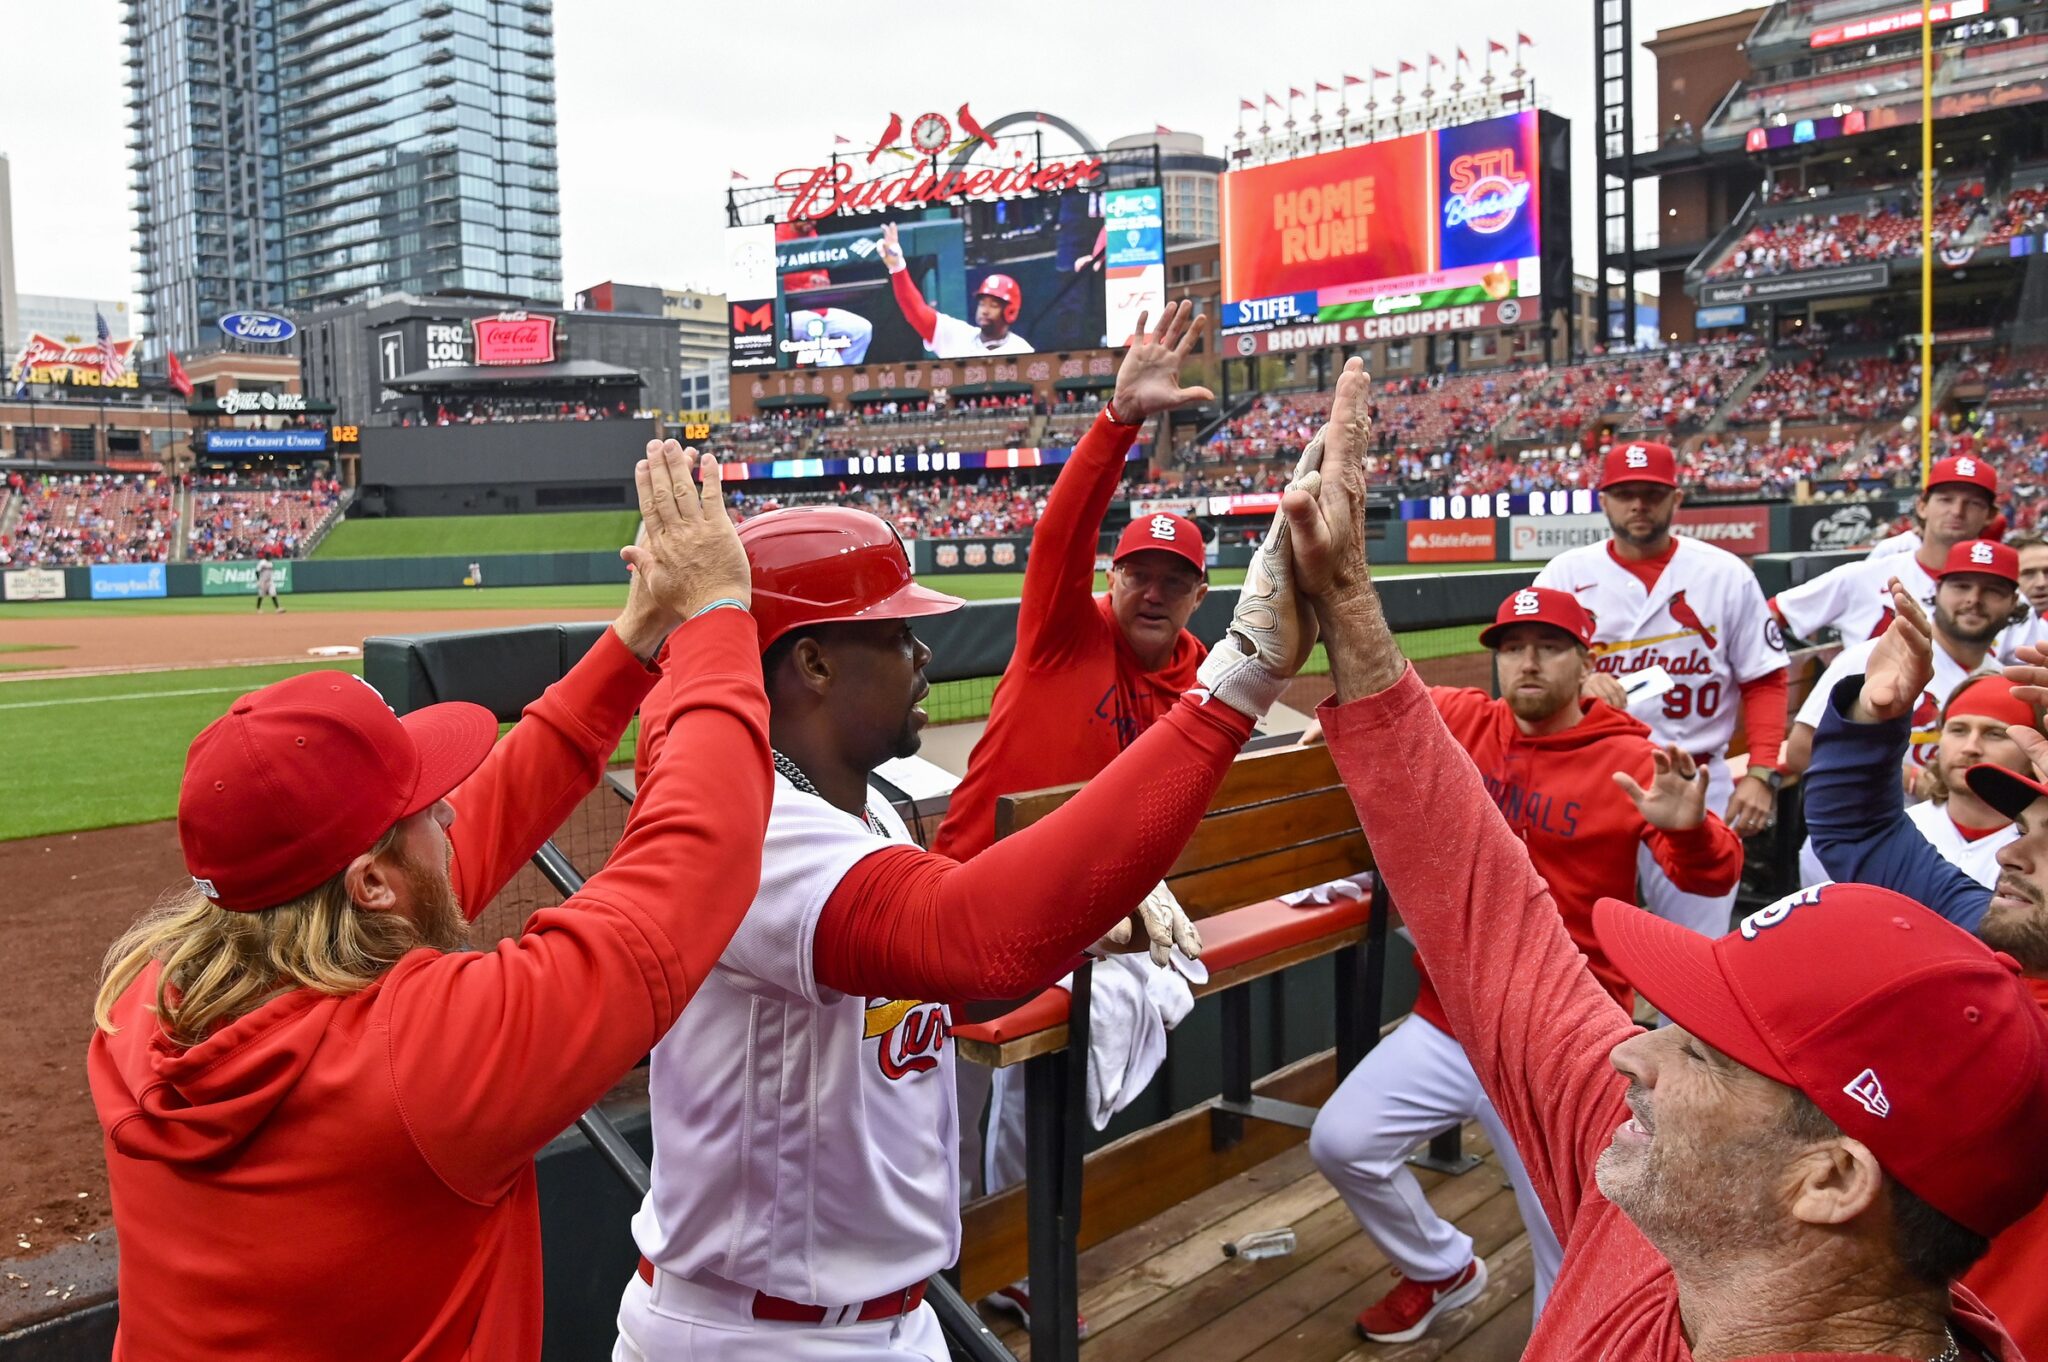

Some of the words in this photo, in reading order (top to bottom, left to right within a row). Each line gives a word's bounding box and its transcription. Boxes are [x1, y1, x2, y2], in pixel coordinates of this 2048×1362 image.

[1449, 148, 1527, 194] STL
[775, 150, 1102, 222] Budweiser
[1273, 176, 1376, 230] HOME
[1281, 217, 1369, 265] RUN!
[788, 248, 849, 266] AMERICA
[1238, 295, 1301, 324] STIFEL
[234, 314, 281, 337] Ford
[427, 325, 463, 343] FRO
[1267, 323, 1341, 352] BROWN
[1345, 326, 1359, 342] &
[1364, 305, 1482, 340] CROUPPEN
[427, 342, 464, 360] LOU
[210, 435, 244, 448] SCOTT
[246, 434, 284, 447] CREDIT
[287, 433, 322, 447] UNION
[847, 455, 906, 475] HOME
[917, 451, 961, 472] RUN
[1429, 493, 1511, 520] HOME
[1528, 489, 1593, 516] RUN
[1668, 522, 1756, 542] QUIFAX
[224, 567, 287, 583] Natial
[1592, 643, 1713, 676] ardinals
[1661, 681, 1722, 720] 90
